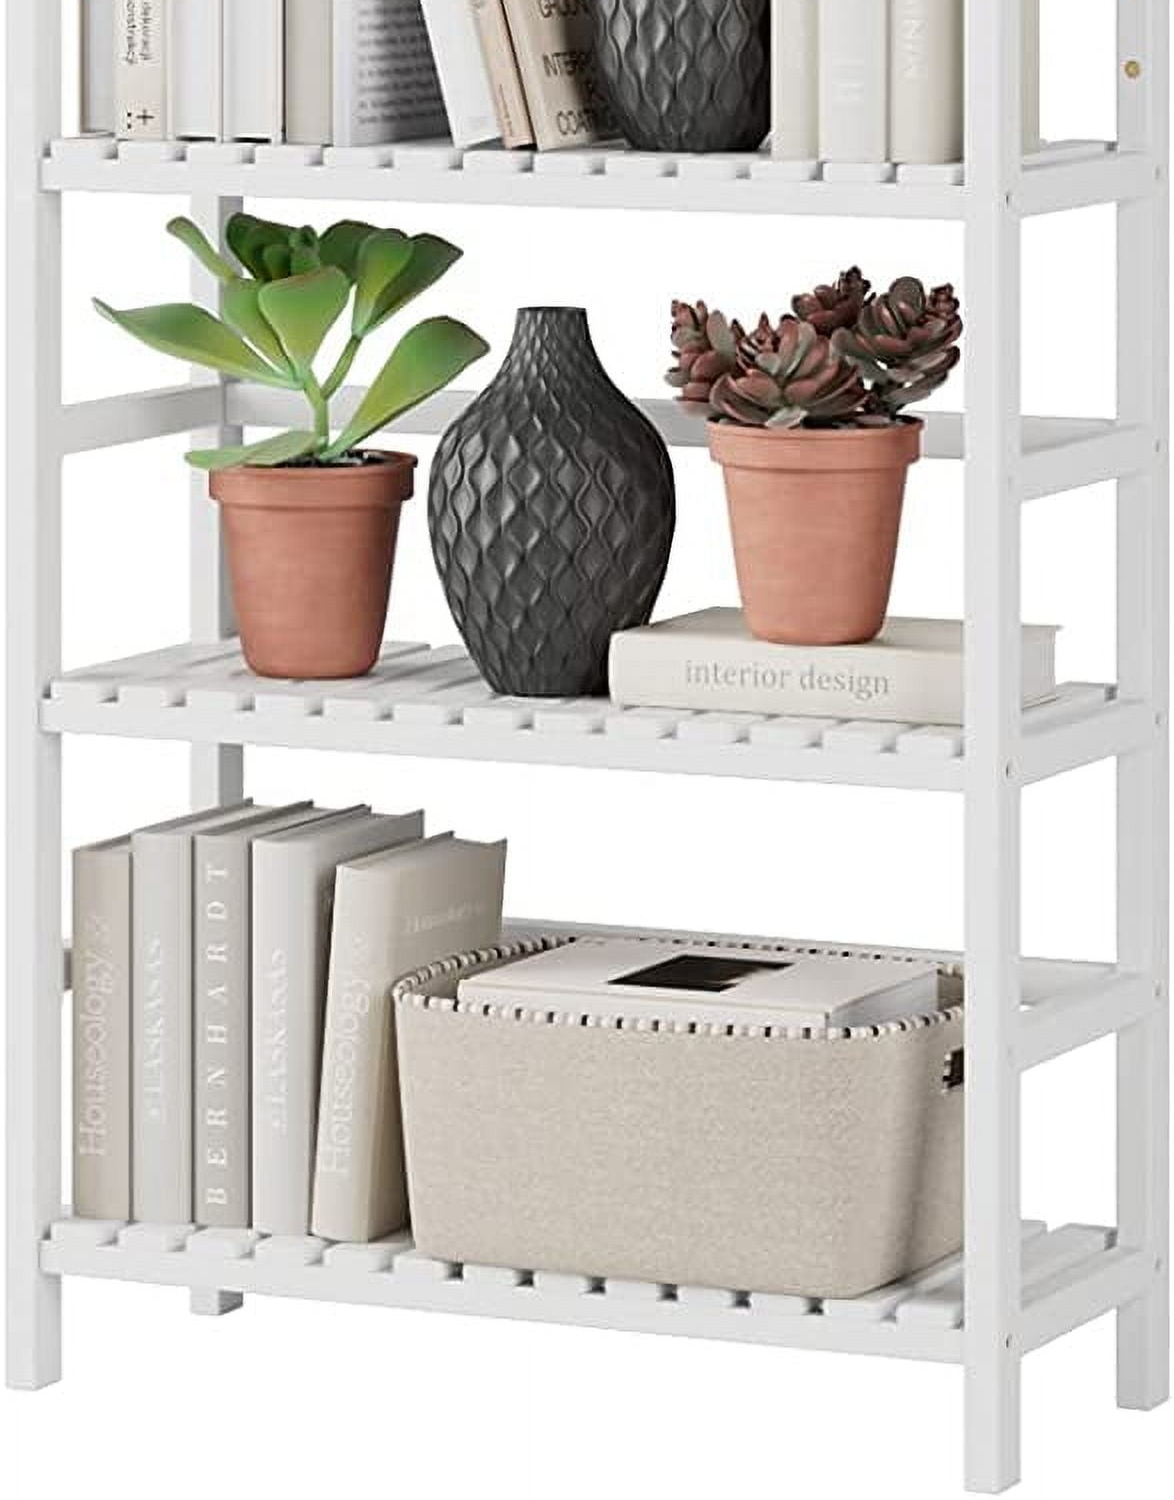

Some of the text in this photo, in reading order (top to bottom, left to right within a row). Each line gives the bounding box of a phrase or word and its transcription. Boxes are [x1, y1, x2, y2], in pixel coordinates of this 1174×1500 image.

[686, 660, 890, 699] interior design
[79, 948, 114, 1156] Houseology
[206, 864, 230, 1206] BERNHARDT
[320, 976, 371, 1174] Houseology
